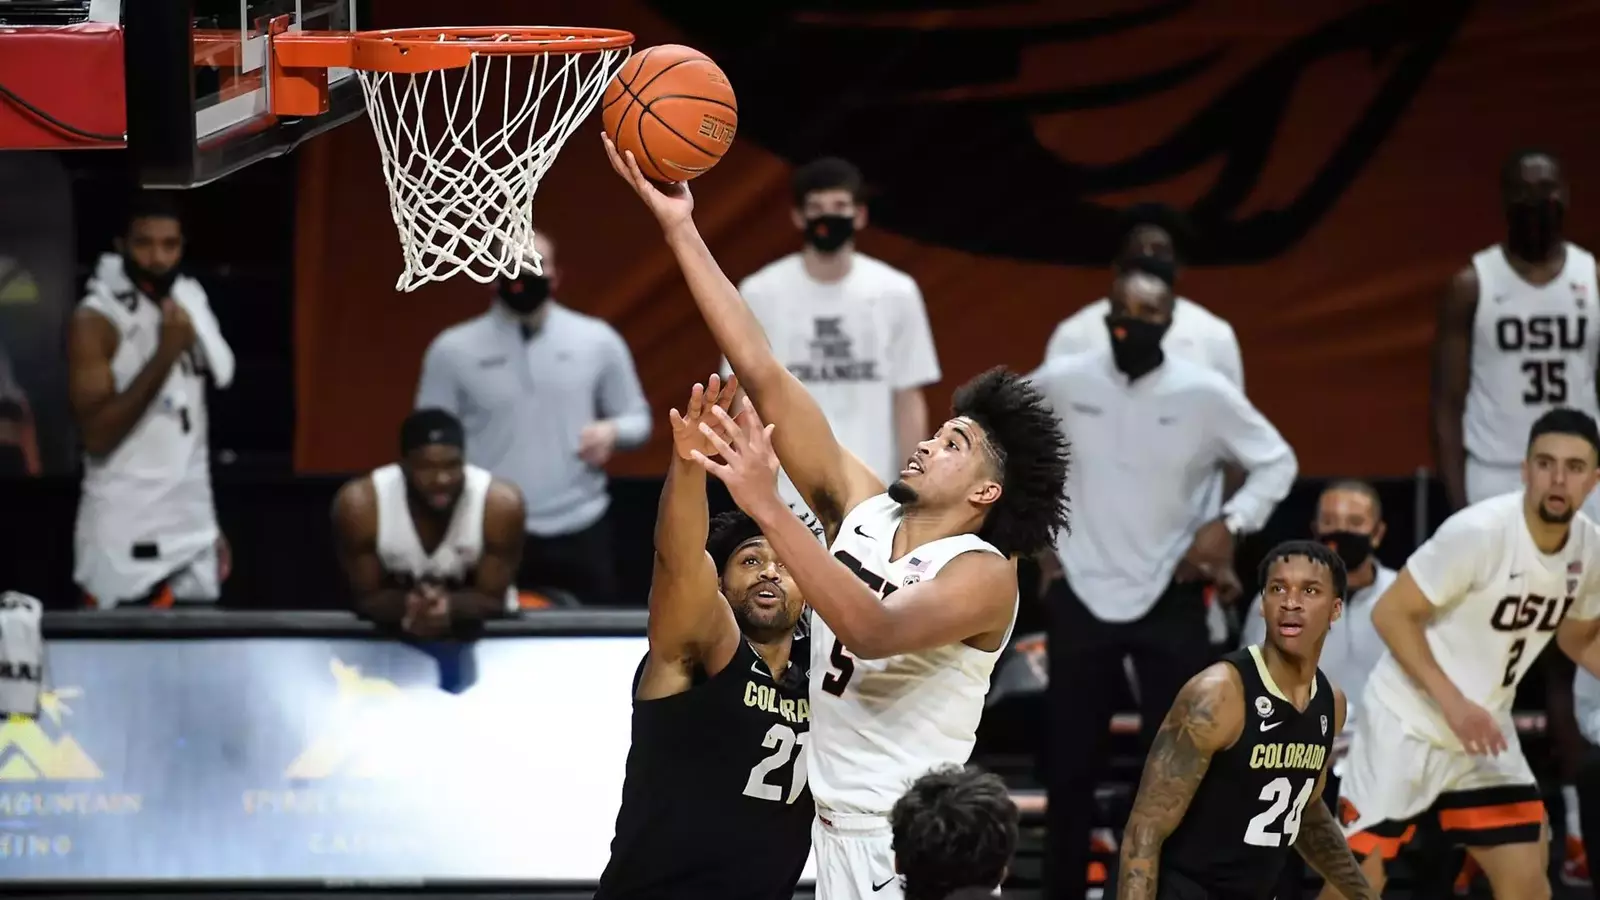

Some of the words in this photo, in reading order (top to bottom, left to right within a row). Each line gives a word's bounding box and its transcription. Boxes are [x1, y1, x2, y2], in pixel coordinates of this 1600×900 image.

[1496, 315, 1588, 352] OSU
[1521, 359, 1568, 405] 35
[1490, 593, 1575, 632] OSU
[821, 637, 855, 698] 5
[1502, 637, 1527, 687] 2
[742, 723, 809, 805] 21
[1249, 743, 1326, 771] COLORADO
[1243, 777, 1315, 847] 24
